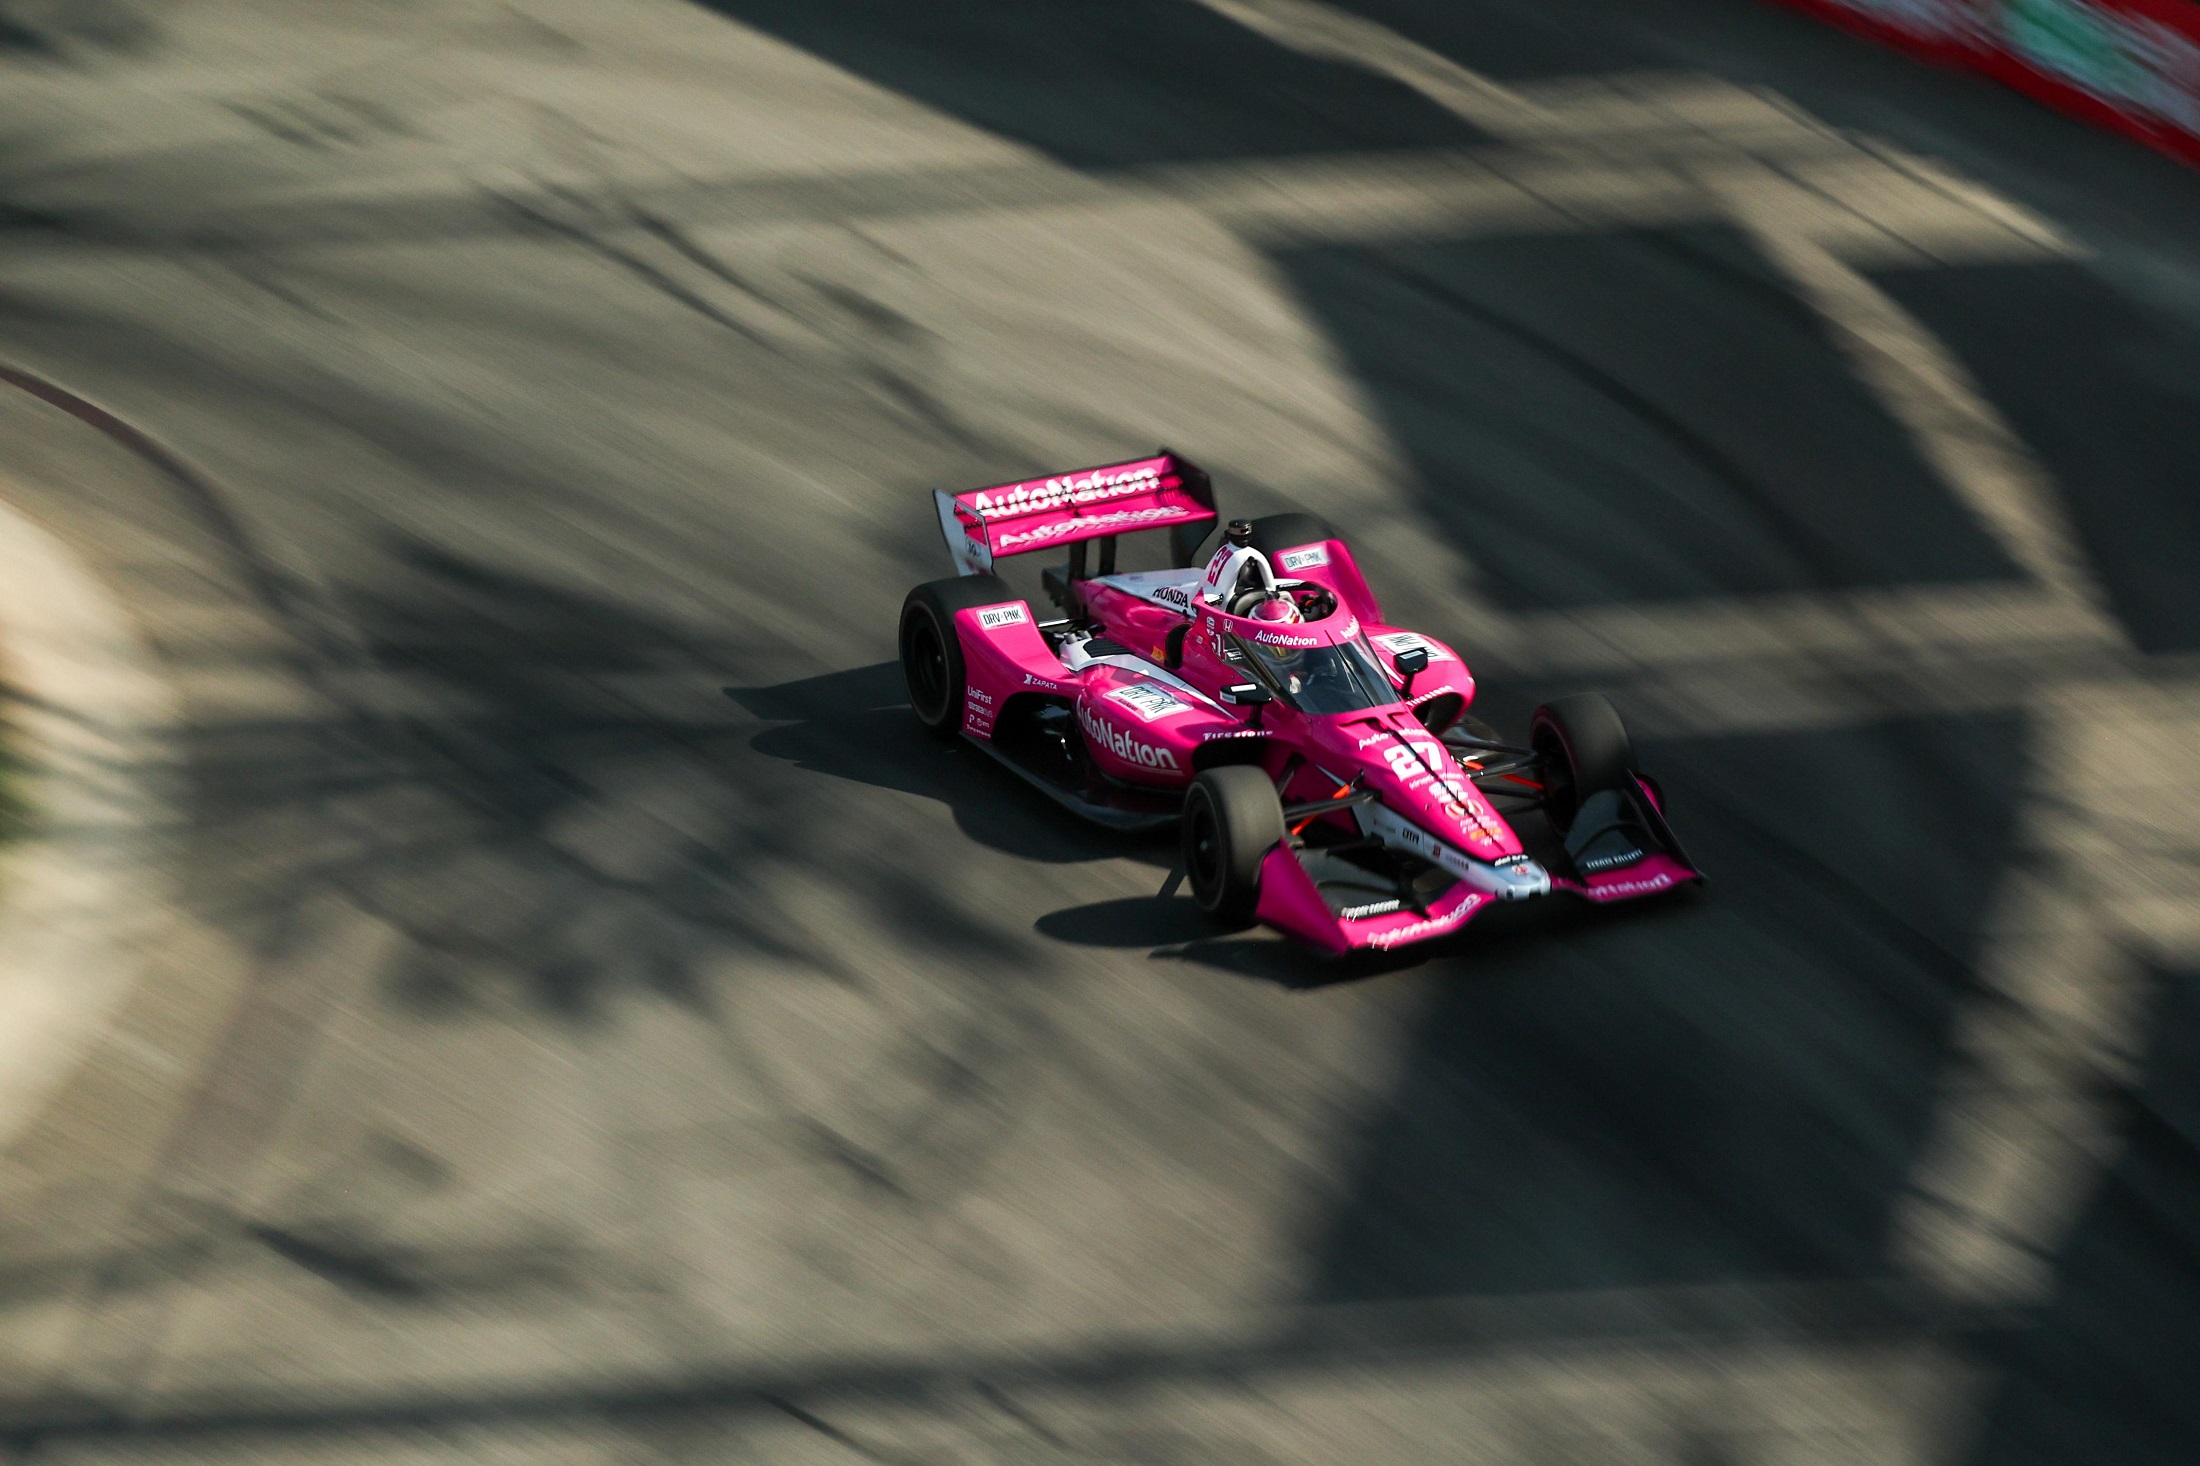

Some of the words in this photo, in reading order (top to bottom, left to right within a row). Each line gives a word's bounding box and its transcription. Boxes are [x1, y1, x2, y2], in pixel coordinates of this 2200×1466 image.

[975, 467, 1160, 518] AutoNation
[1152, 587, 1189, 608] HONDA
[982, 612, 1001, 625] DRV
[1003, 609, 1022, 621] PNK
[1255, 629, 1318, 647] AutoNation
[1032, 677, 1058, 690] ZAPATA
[967, 685, 992, 705] UniFirst
[1076, 694, 1179, 769] AutoNation
[1383, 741, 1443, 783] 27
